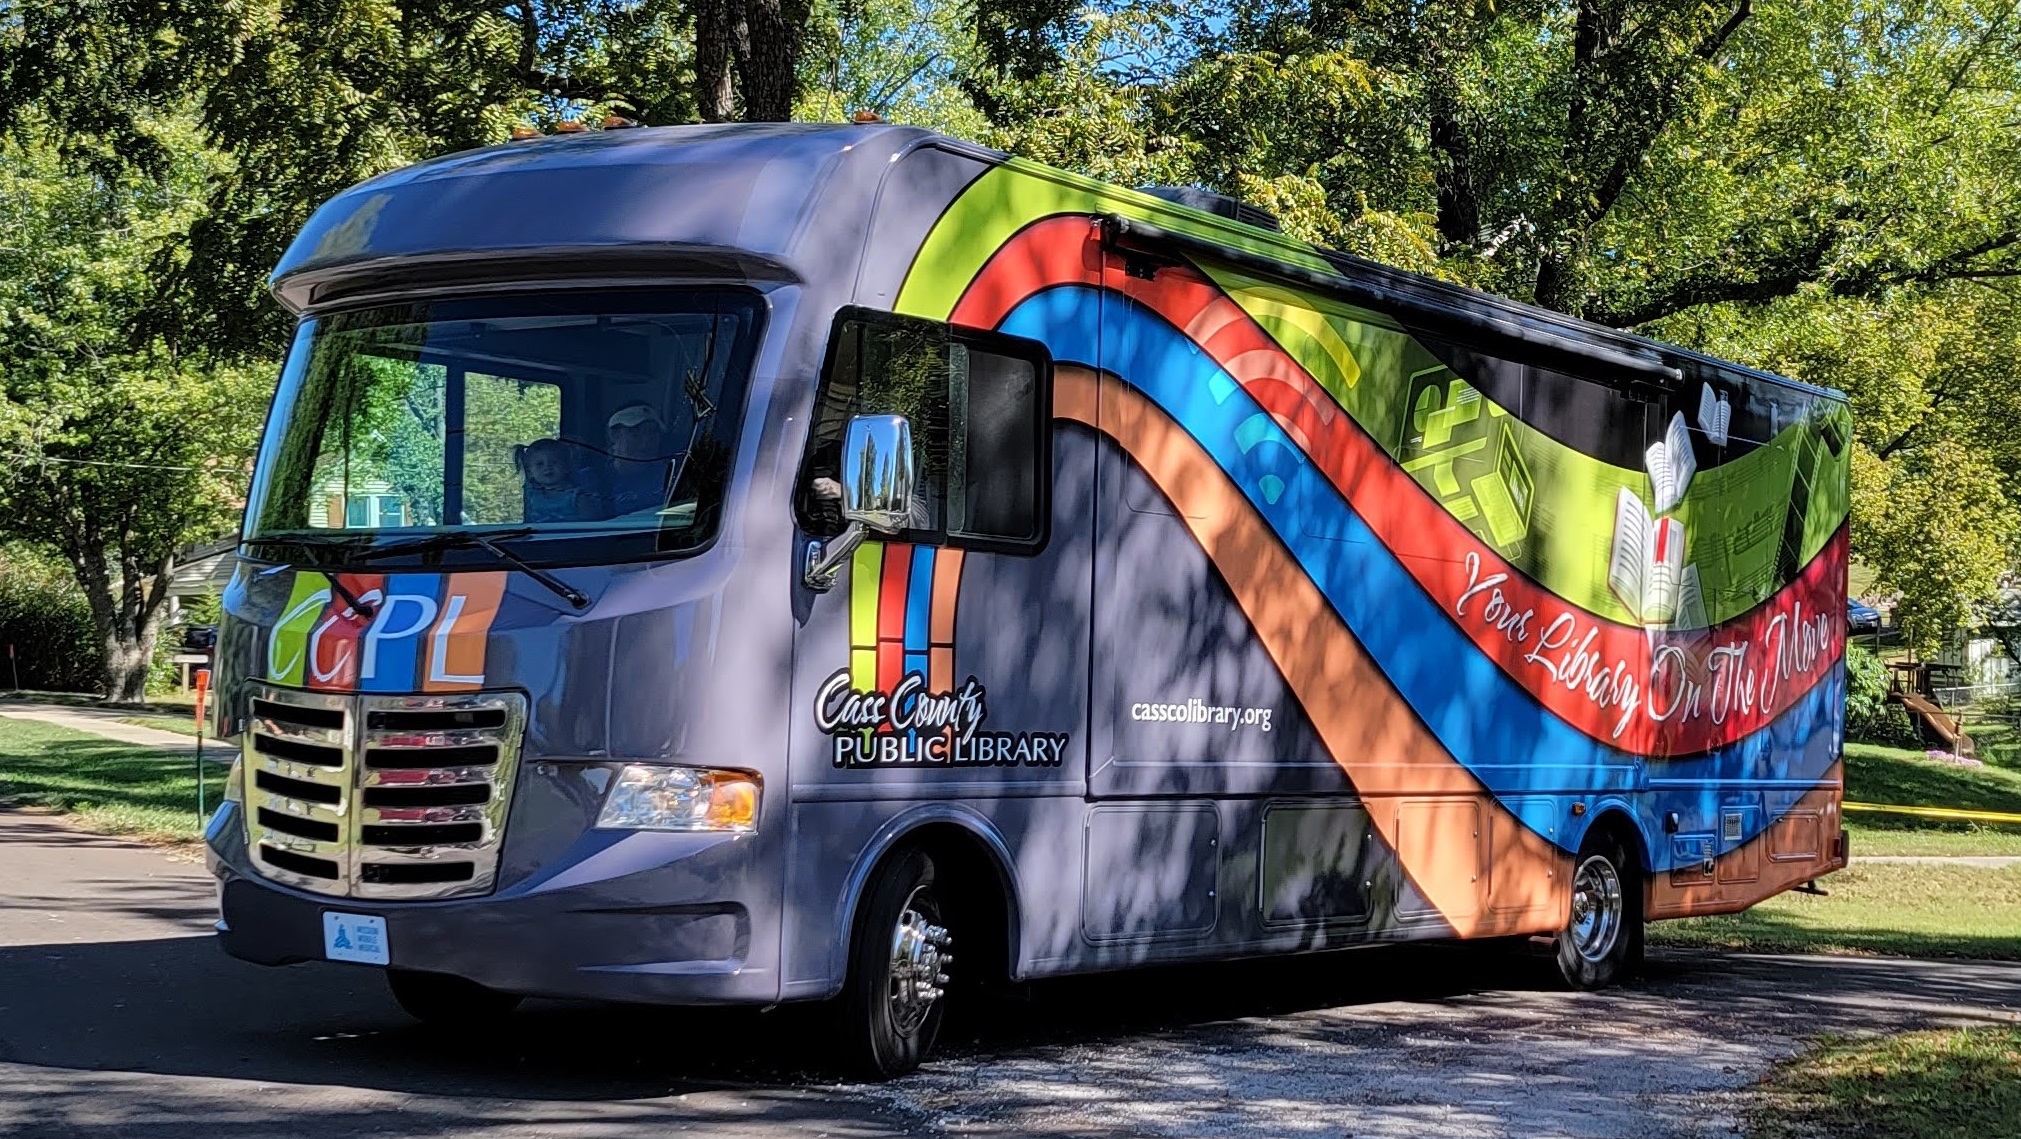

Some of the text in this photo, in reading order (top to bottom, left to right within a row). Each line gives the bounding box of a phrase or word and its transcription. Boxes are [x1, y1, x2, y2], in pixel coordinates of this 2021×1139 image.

[268, 588, 486, 684] CCPL
[1456, 551, 1830, 739] Your Library On The Move
[817, 672, 985, 746] Cass County
[1131, 698, 1273, 732] casscolibrary.org
[835, 736, 1066, 763] PUBLIC LIBRARY
